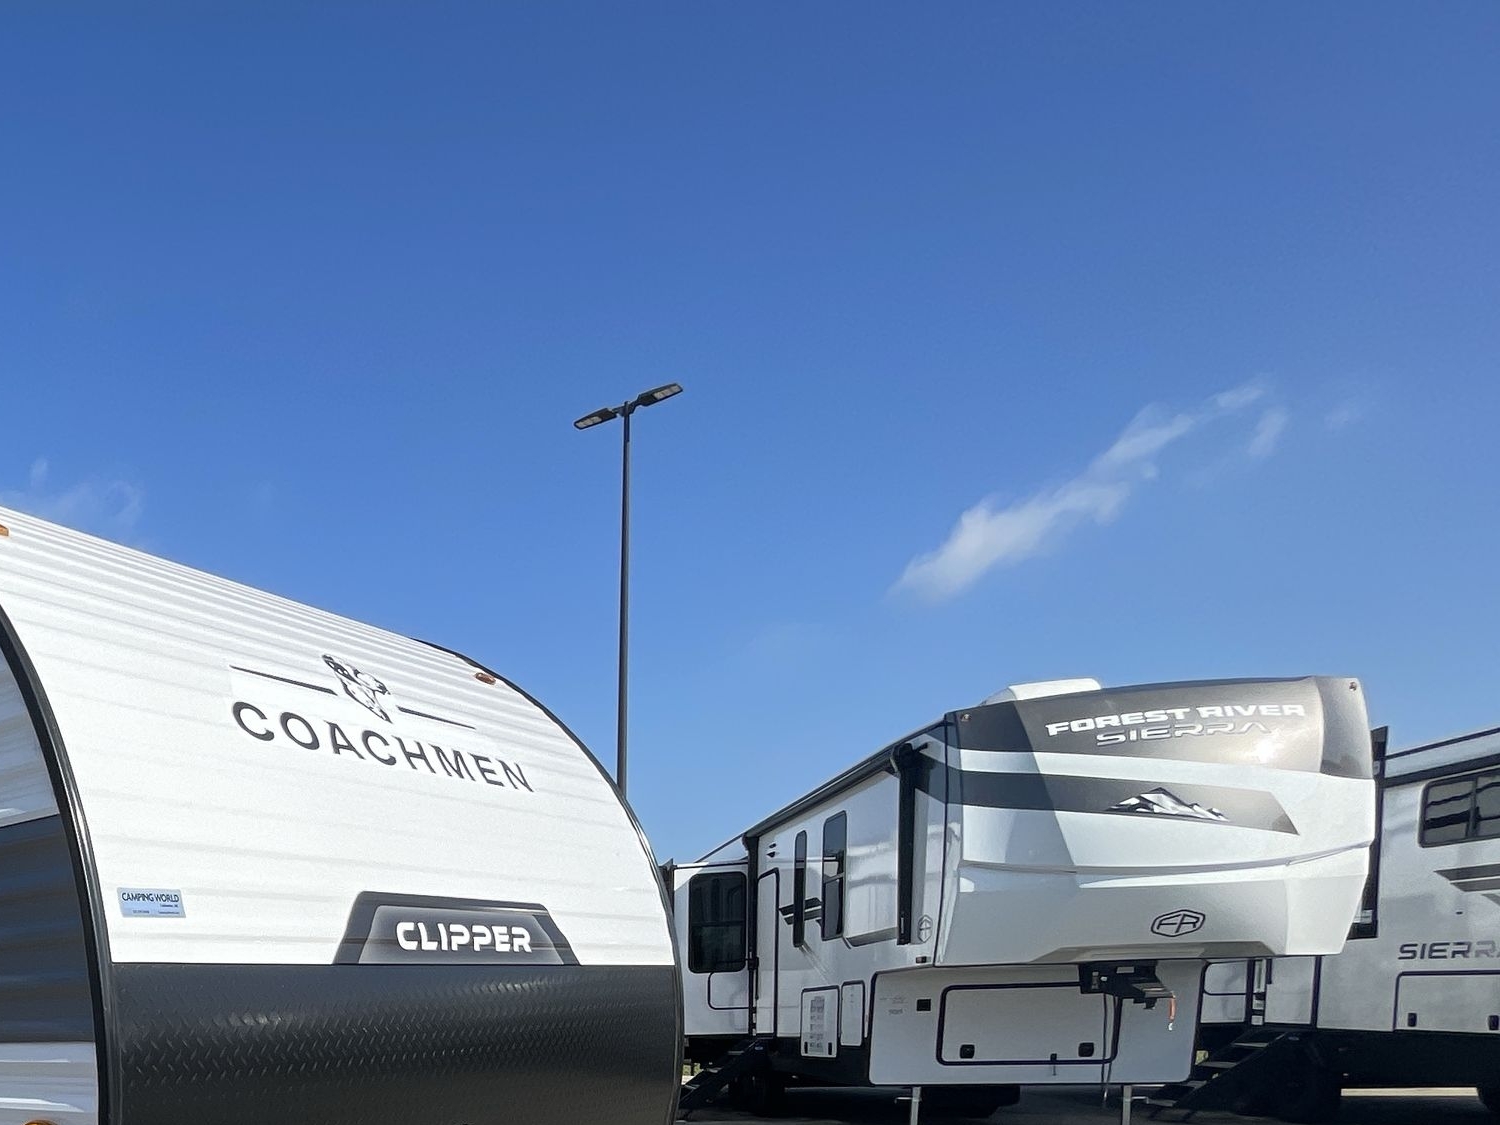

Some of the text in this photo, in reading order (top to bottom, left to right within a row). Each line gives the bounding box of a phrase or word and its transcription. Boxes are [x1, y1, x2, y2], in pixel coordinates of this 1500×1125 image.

[1045, 704, 1306, 737] FOREST RIVER
[1096, 721, 1273, 747] SIERRA
[232, 700, 535, 793] COACHMEN
[121, 892, 180, 903] CAMPING WORLD
[395, 921, 533, 953] CLIPPER
[1397, 941, 1500, 960] SIERR
